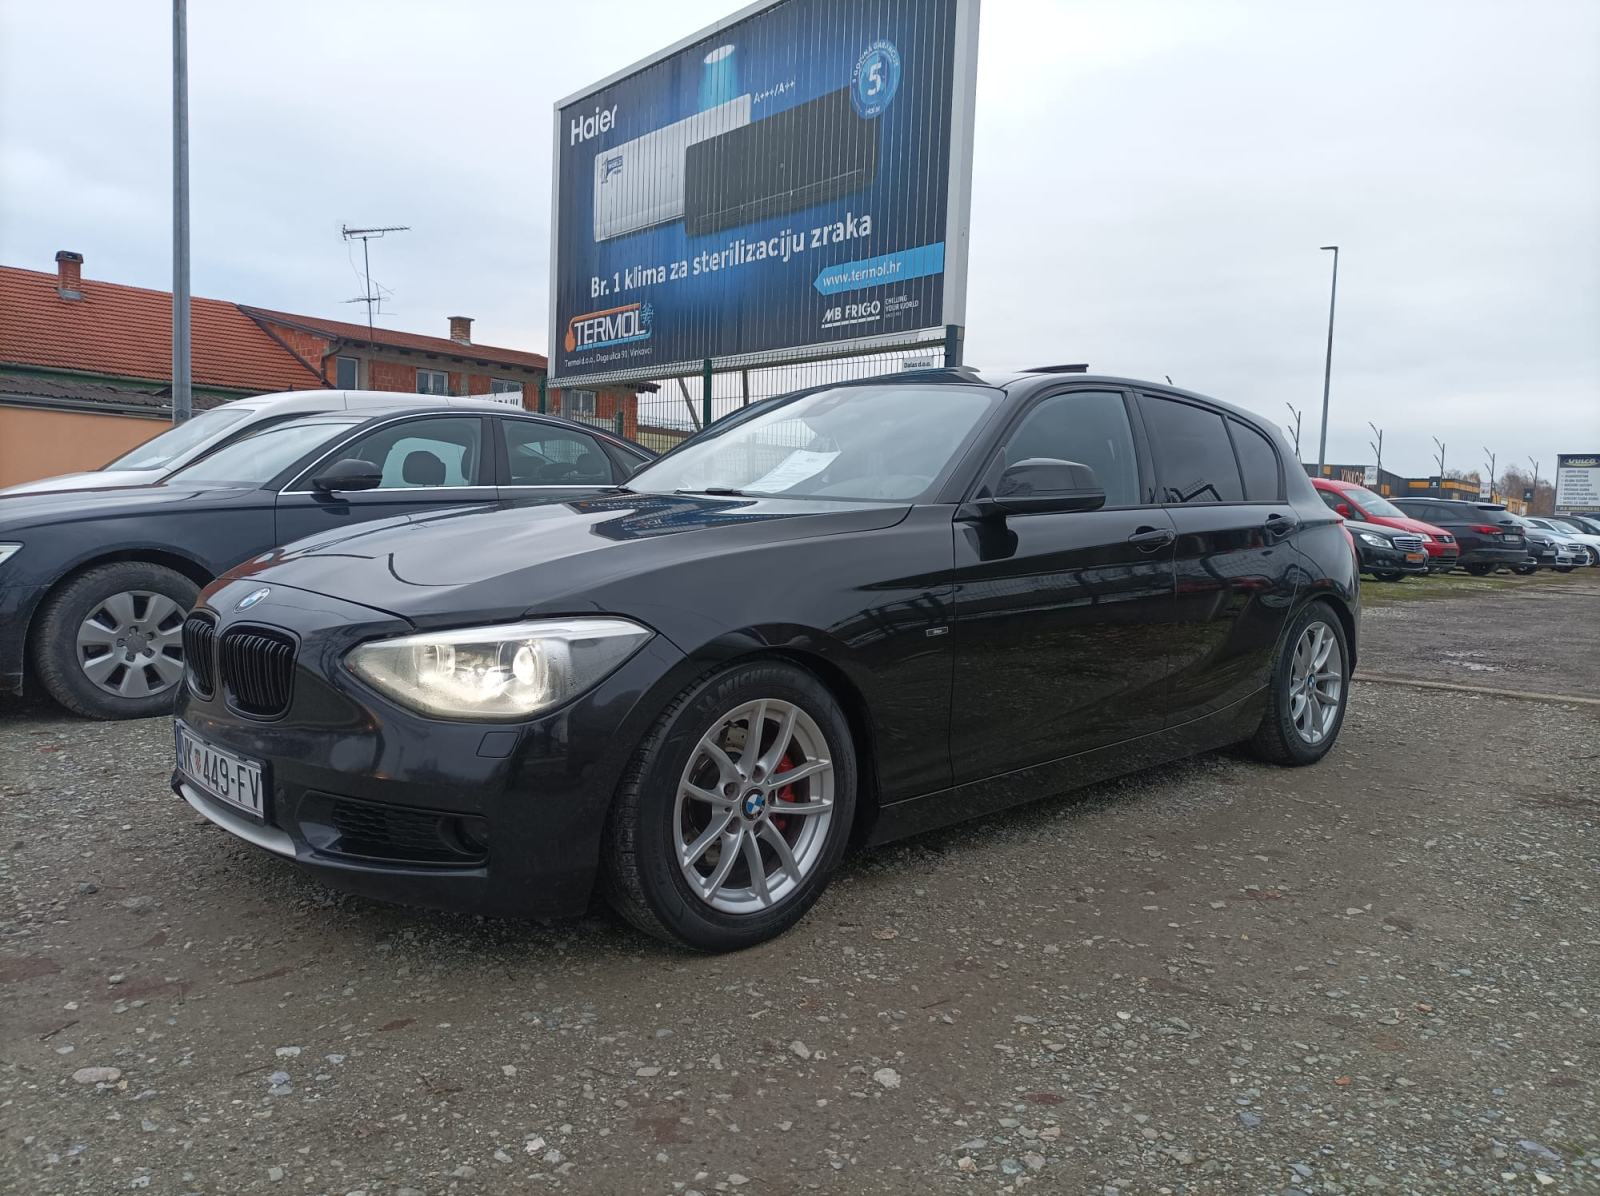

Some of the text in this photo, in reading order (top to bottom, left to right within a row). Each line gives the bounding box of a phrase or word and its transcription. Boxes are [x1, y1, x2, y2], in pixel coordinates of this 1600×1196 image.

[867, 62, 882, 96] 5
[571, 104, 617, 146] Haier
[591, 212, 872, 298] Br. 1 klima za sterilizaciju zraka
[822, 261, 902, 287] www.termol.hr
[821, 300, 881, 323] MB FRIGO
[900, 300, 919, 310] WORLD
[574, 310, 647, 346] TERMOL
[203, 749, 259, 809] 449-FV
